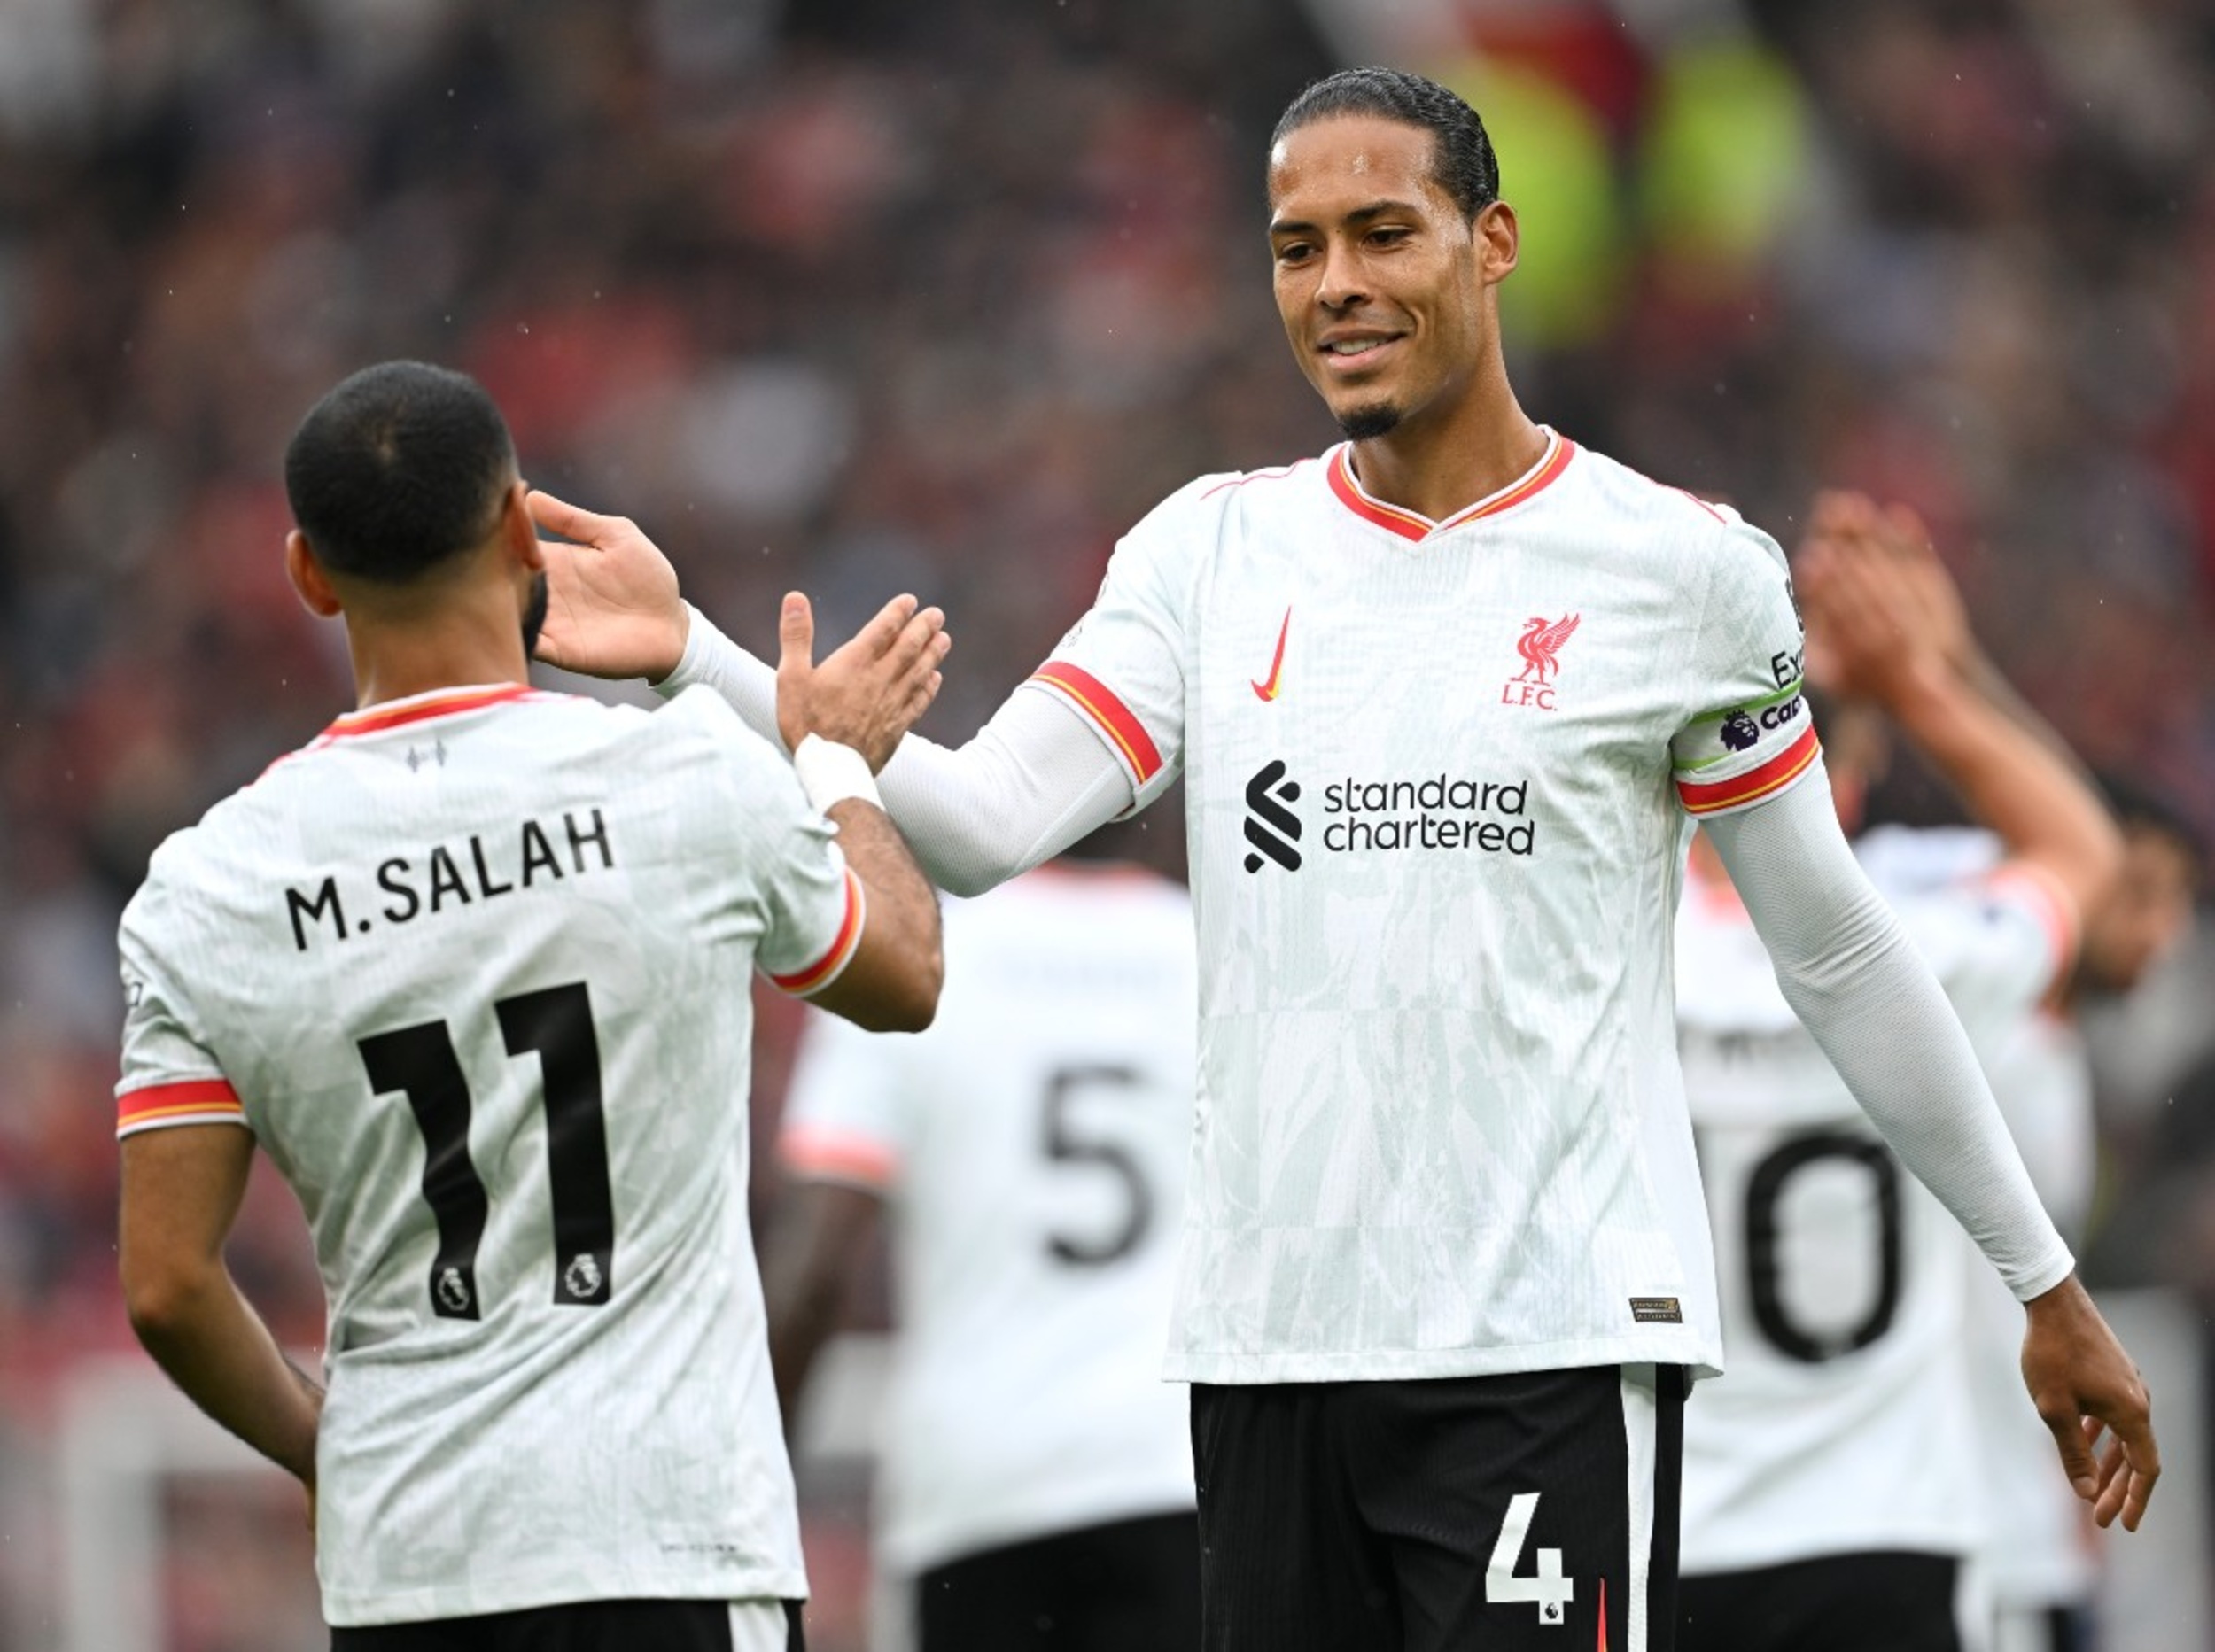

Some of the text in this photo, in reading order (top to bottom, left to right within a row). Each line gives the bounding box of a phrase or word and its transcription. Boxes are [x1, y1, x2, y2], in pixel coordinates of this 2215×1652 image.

[1501, 684, 1558, 712] L.F.C.
[1324, 812, 1535, 856] chartered
[1325, 772, 1527, 815] standard
[285, 809, 614, 952] M.SALAH
[357, 981, 614, 1321] 11
[1037, 1059, 1157, 1272] 5
[1485, 1492, 1574, 1625] 4
